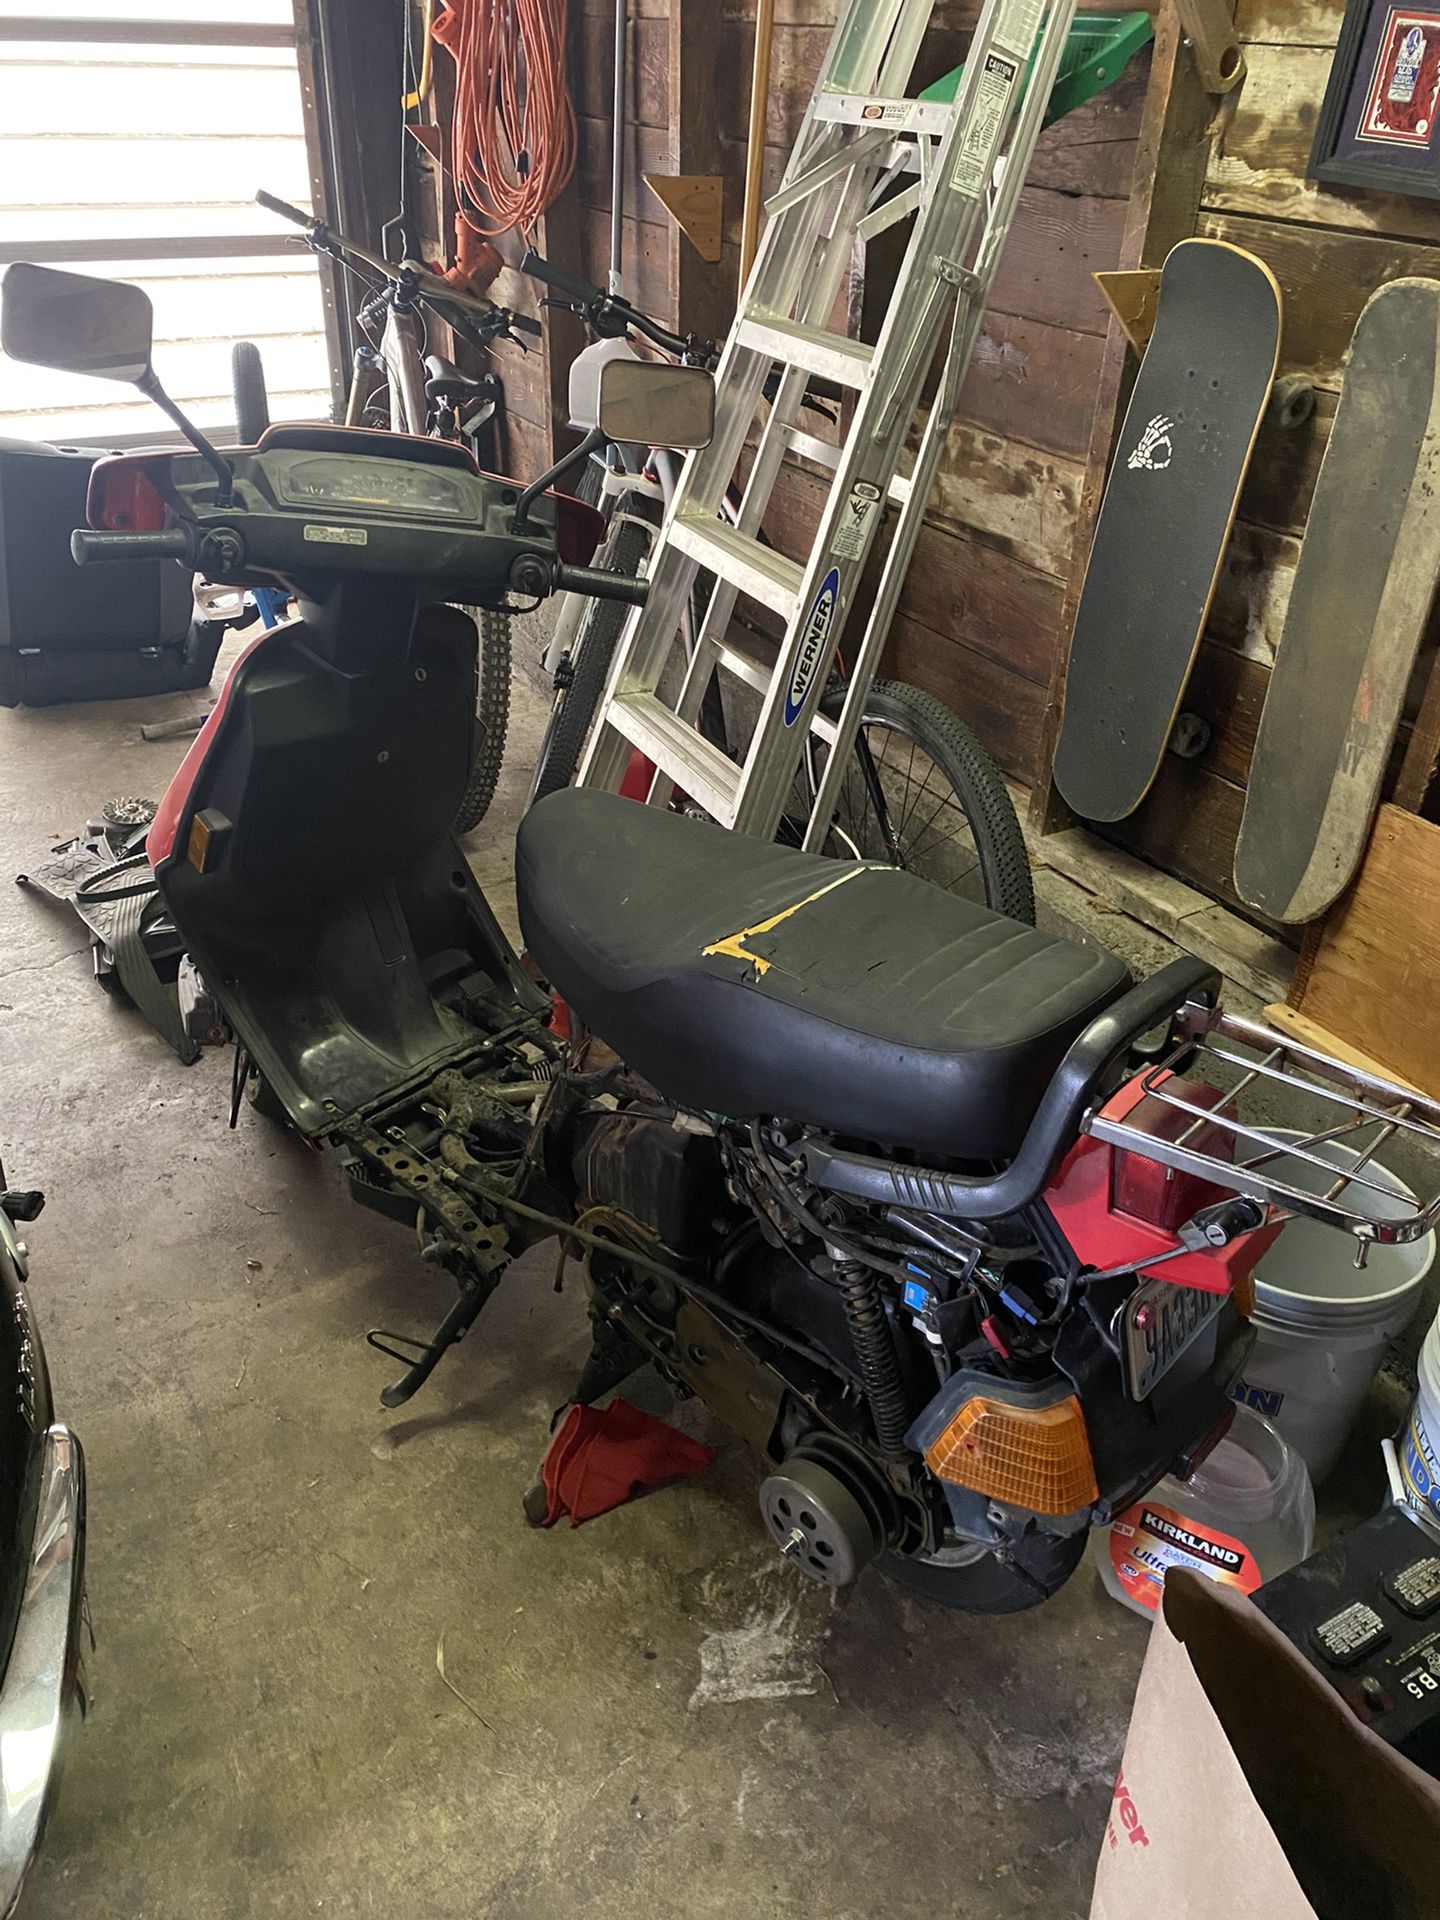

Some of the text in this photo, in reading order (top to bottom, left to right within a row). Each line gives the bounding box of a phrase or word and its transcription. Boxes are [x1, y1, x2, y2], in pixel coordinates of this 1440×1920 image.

[988, 57, 1013, 77] CAUTION
[793, 598, 831, 695] WERNER
[1144, 1512, 1240, 1564] KIRKLAND
